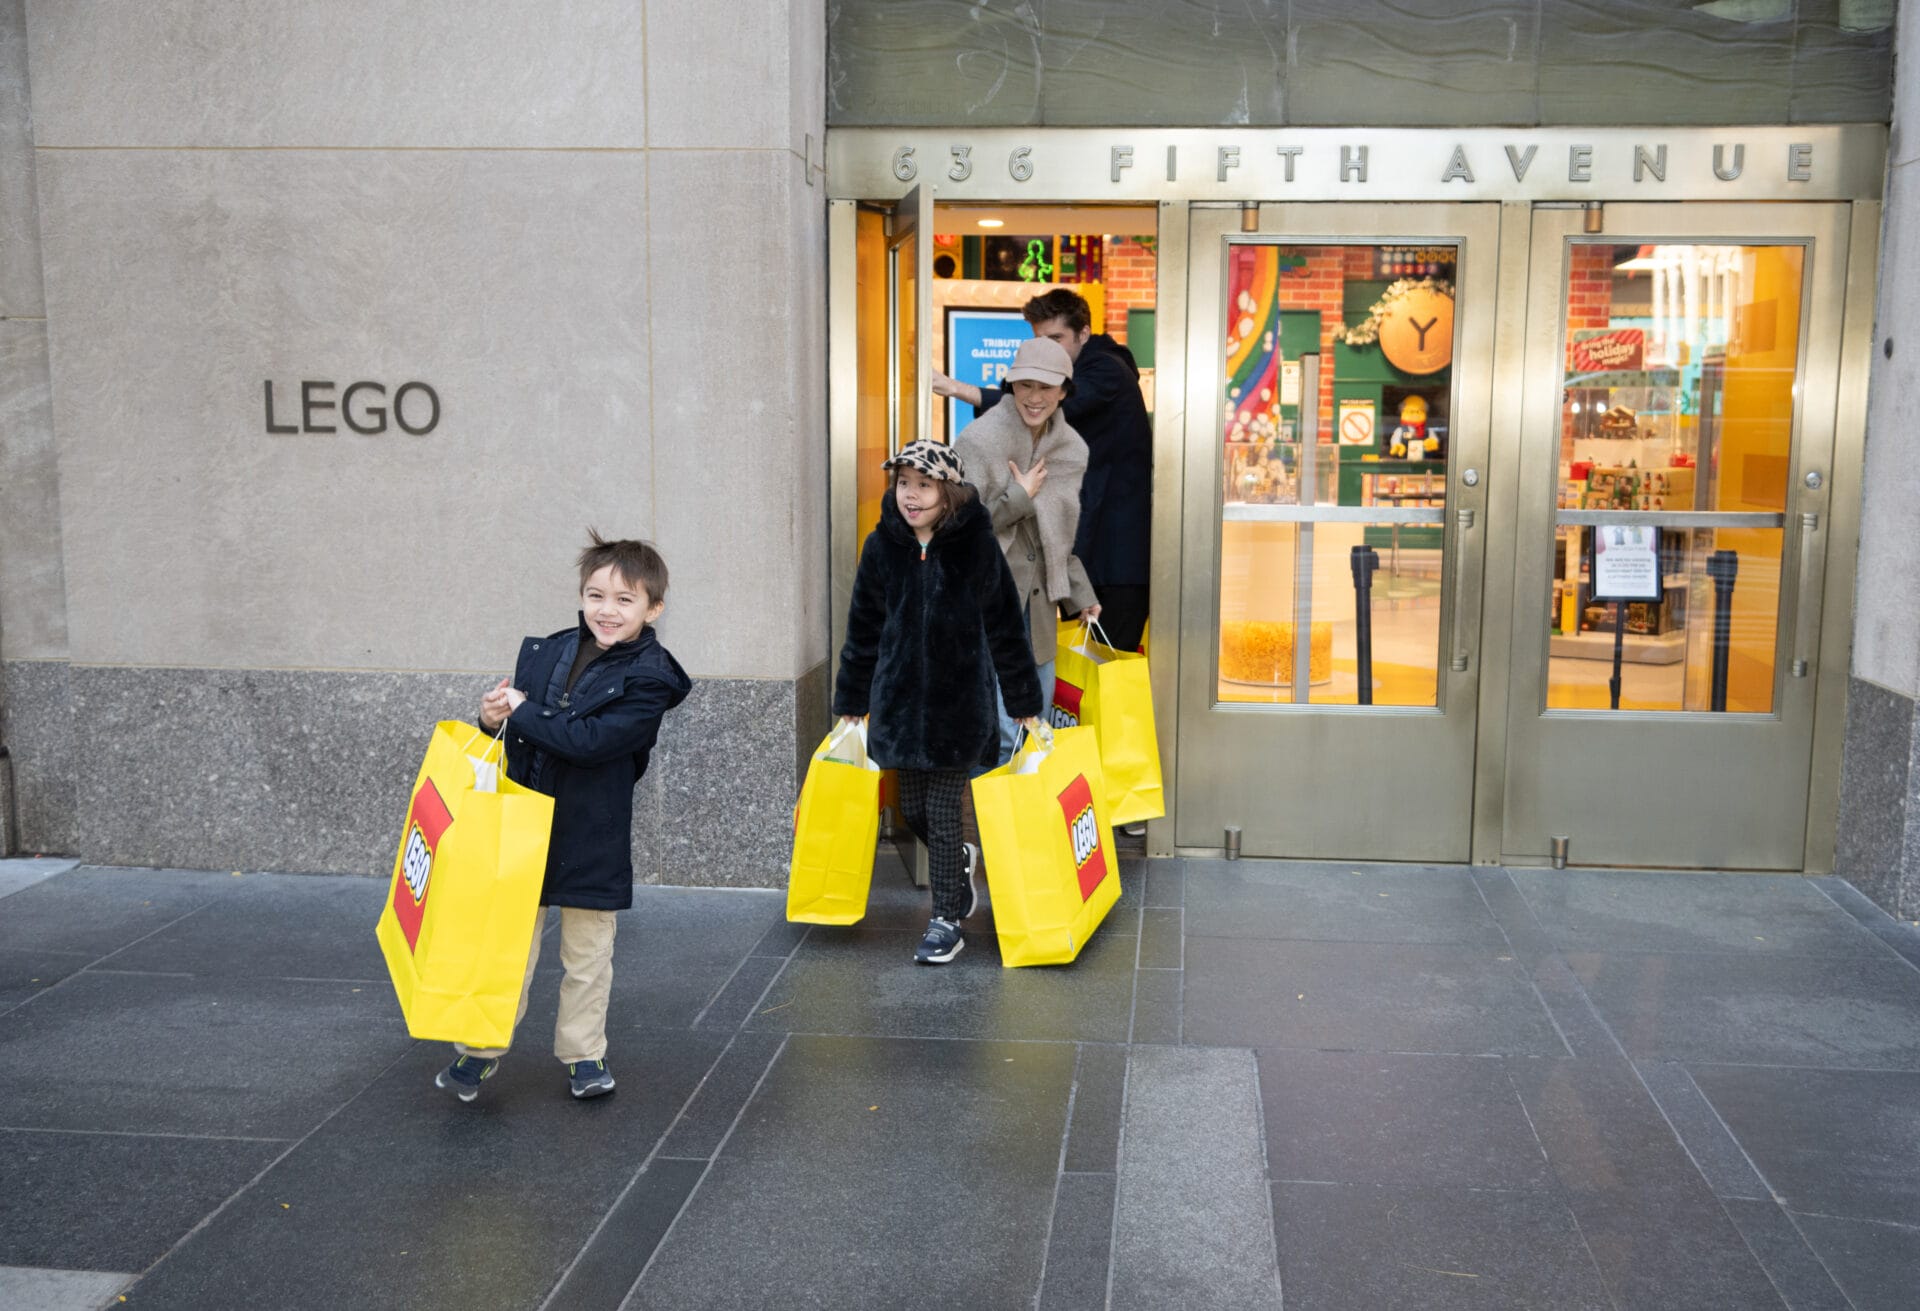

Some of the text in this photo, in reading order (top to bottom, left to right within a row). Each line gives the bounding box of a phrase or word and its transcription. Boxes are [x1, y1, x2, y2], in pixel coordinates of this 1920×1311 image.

[892, 143, 1813, 183] 636 FIFTH AVENUE
[982, 338, 1022, 348] TRIBUTE
[1408, 315, 1438, 352] Y
[1589, 342, 1636, 361] holiday
[971, 348, 1012, 359] GALILEO
[982, 362, 1008, 382] FR
[264, 379, 441, 436] LEGO
[1072, 805, 1098, 866] LEGO
[403, 823, 431, 902] LEGO
